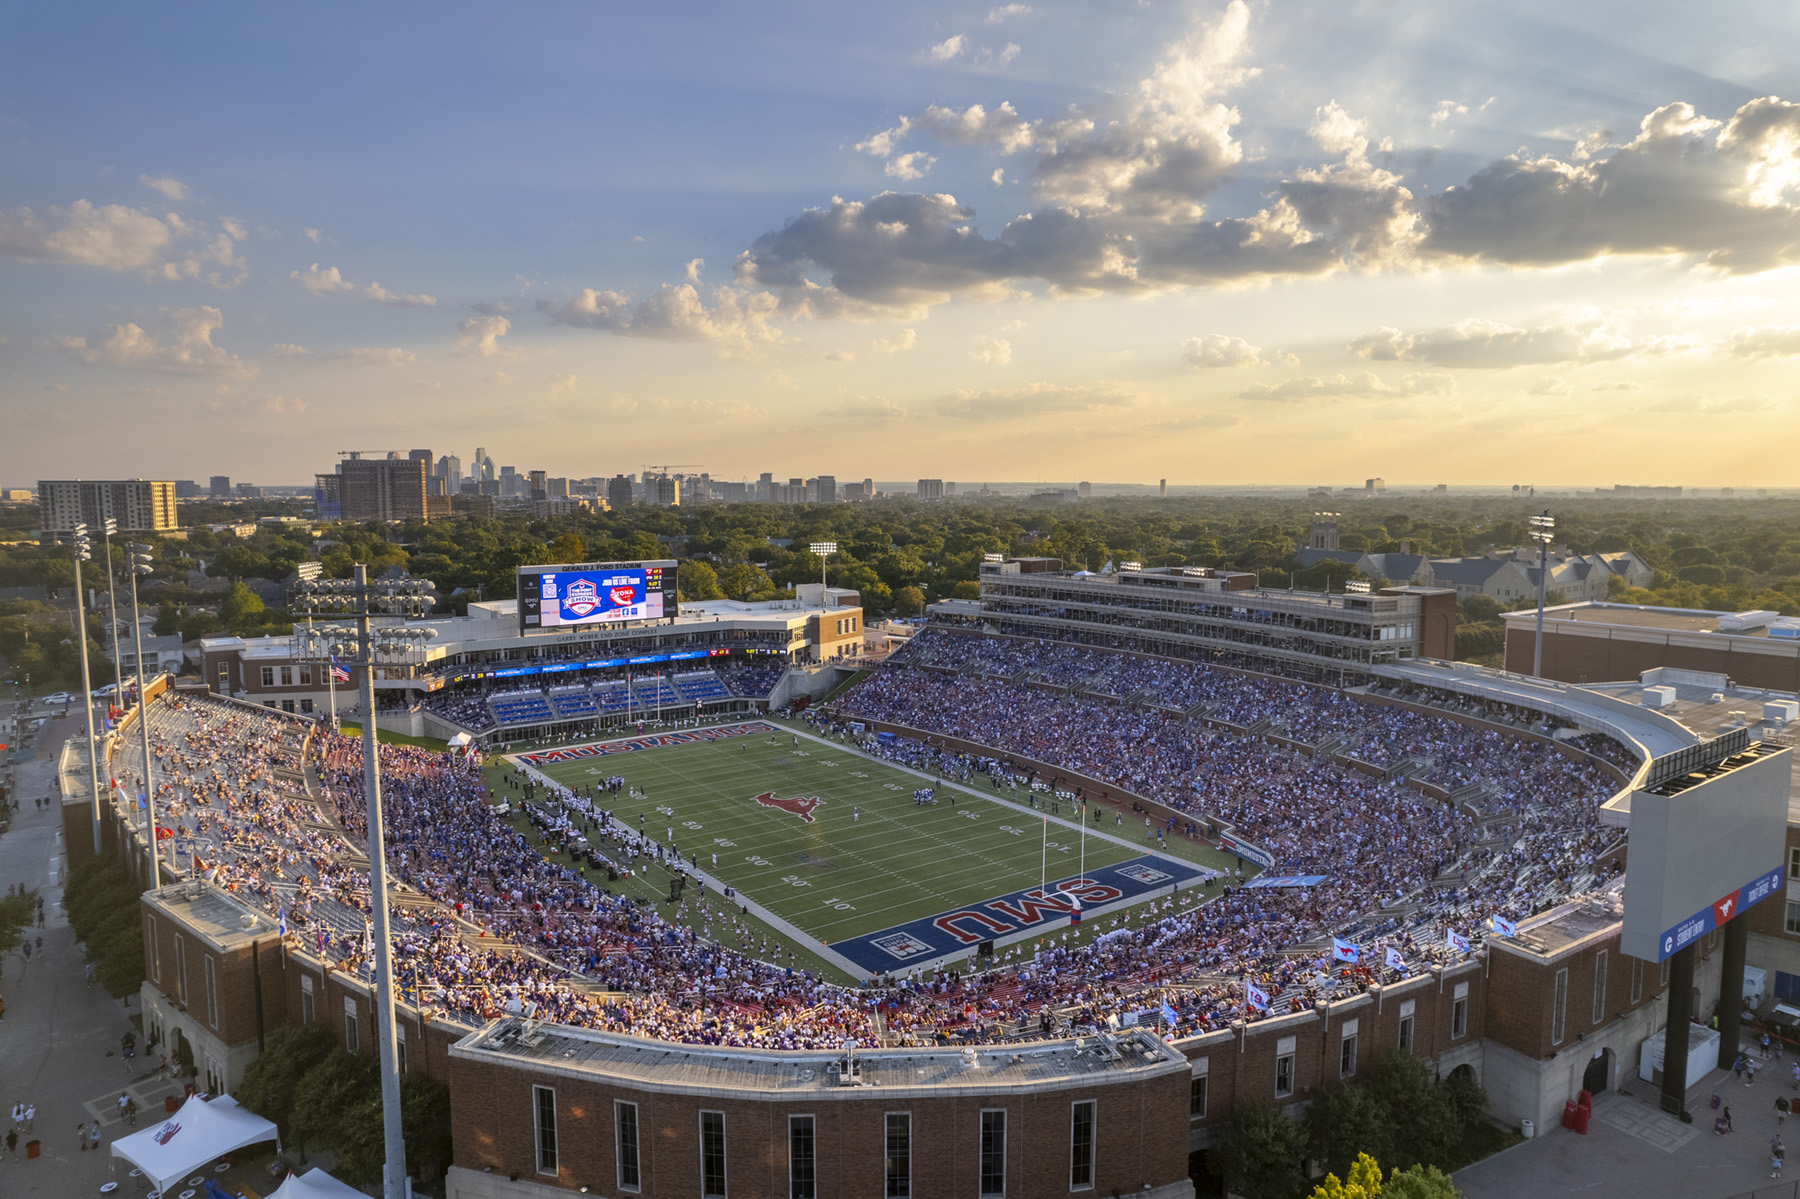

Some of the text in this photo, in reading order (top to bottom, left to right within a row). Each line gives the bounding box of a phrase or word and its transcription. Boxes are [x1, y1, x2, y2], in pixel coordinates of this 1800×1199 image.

[522, 723, 774, 764] MUSTANGS
[682, 821, 703, 830] 50
[745, 856, 769, 866] 30
[781, 875, 808, 887] 20
[822, 898, 851, 910] 10
[932, 878, 1123, 945] SMU
[1677, 919, 1705, 947] STUDENT ENTRY
[1250, 991, 1262, 1004] 19
